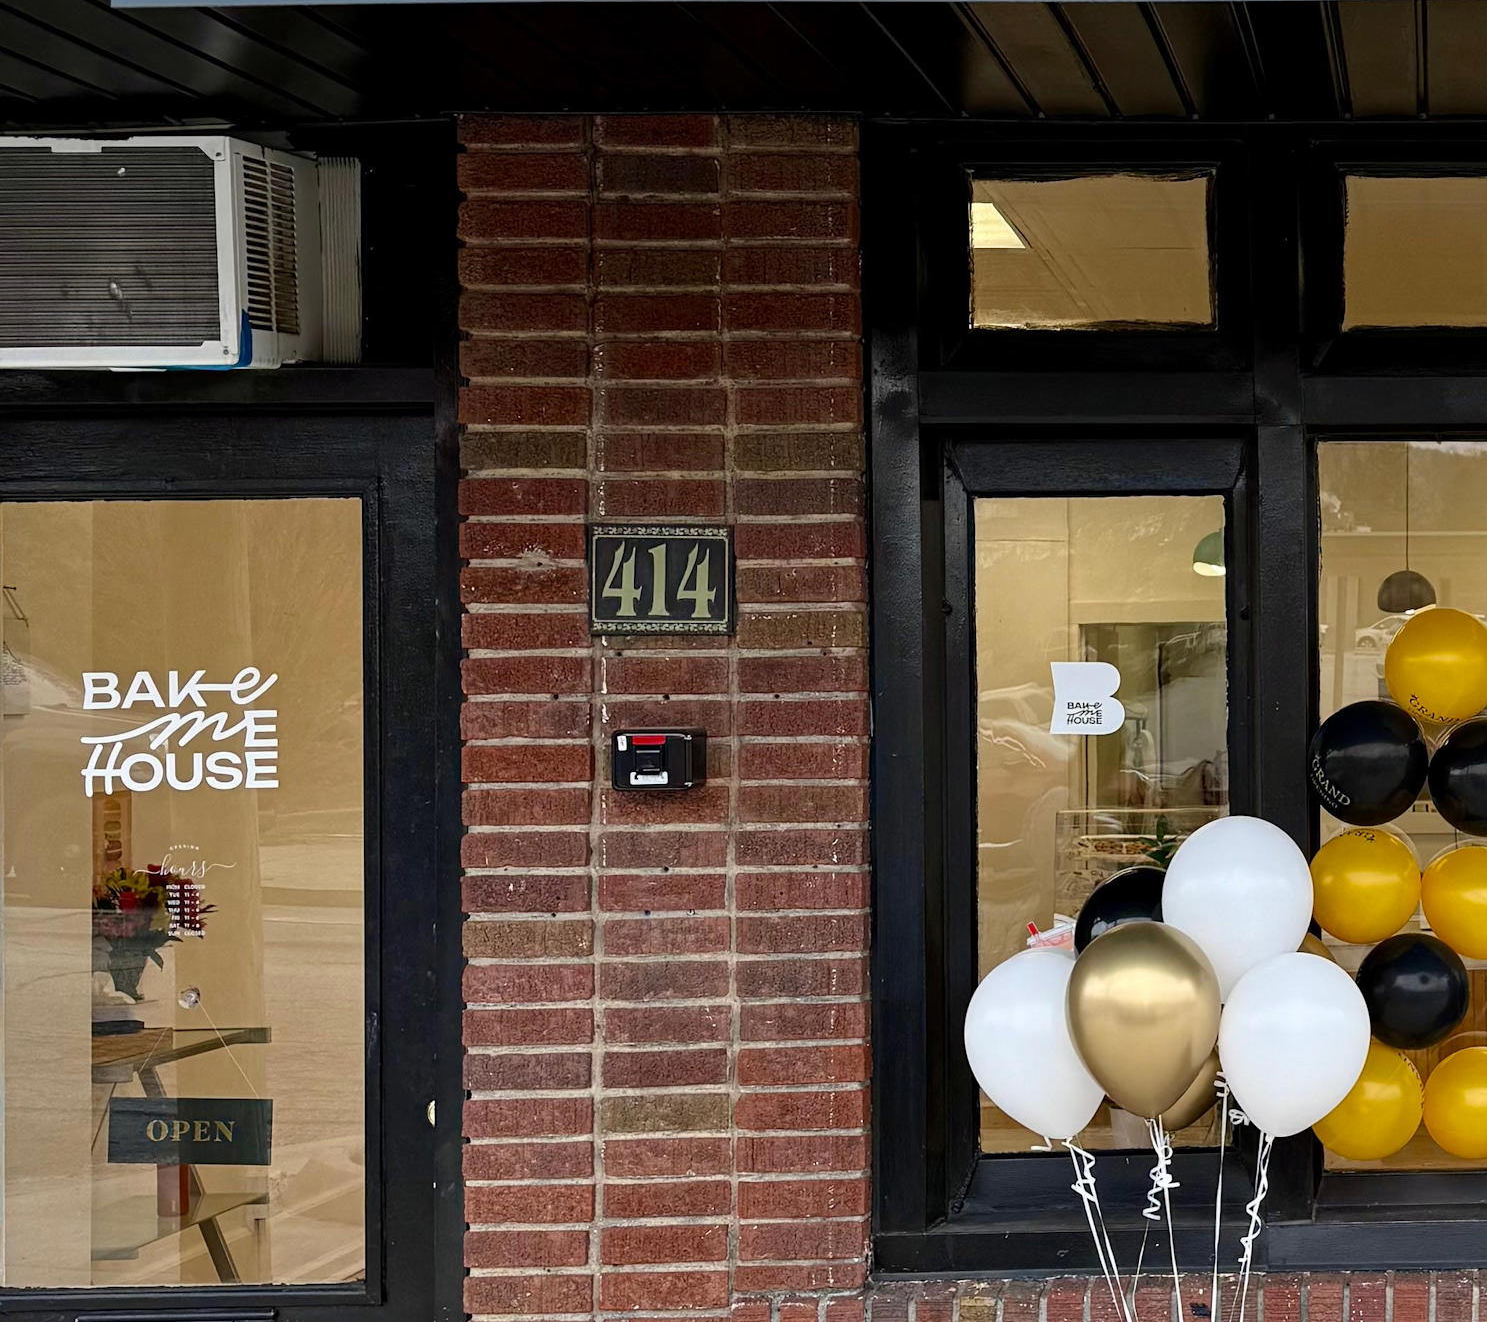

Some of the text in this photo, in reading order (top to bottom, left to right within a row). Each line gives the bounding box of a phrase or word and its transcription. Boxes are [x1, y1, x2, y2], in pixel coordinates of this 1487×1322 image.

[601, 540, 717, 618] 414
[1067, 714, 1103, 725] HOUSE
[80, 741, 280, 798] HOUSE
[1312, 758, 1351, 806] GRAND
[146, 1119, 237, 1143] OPEN
